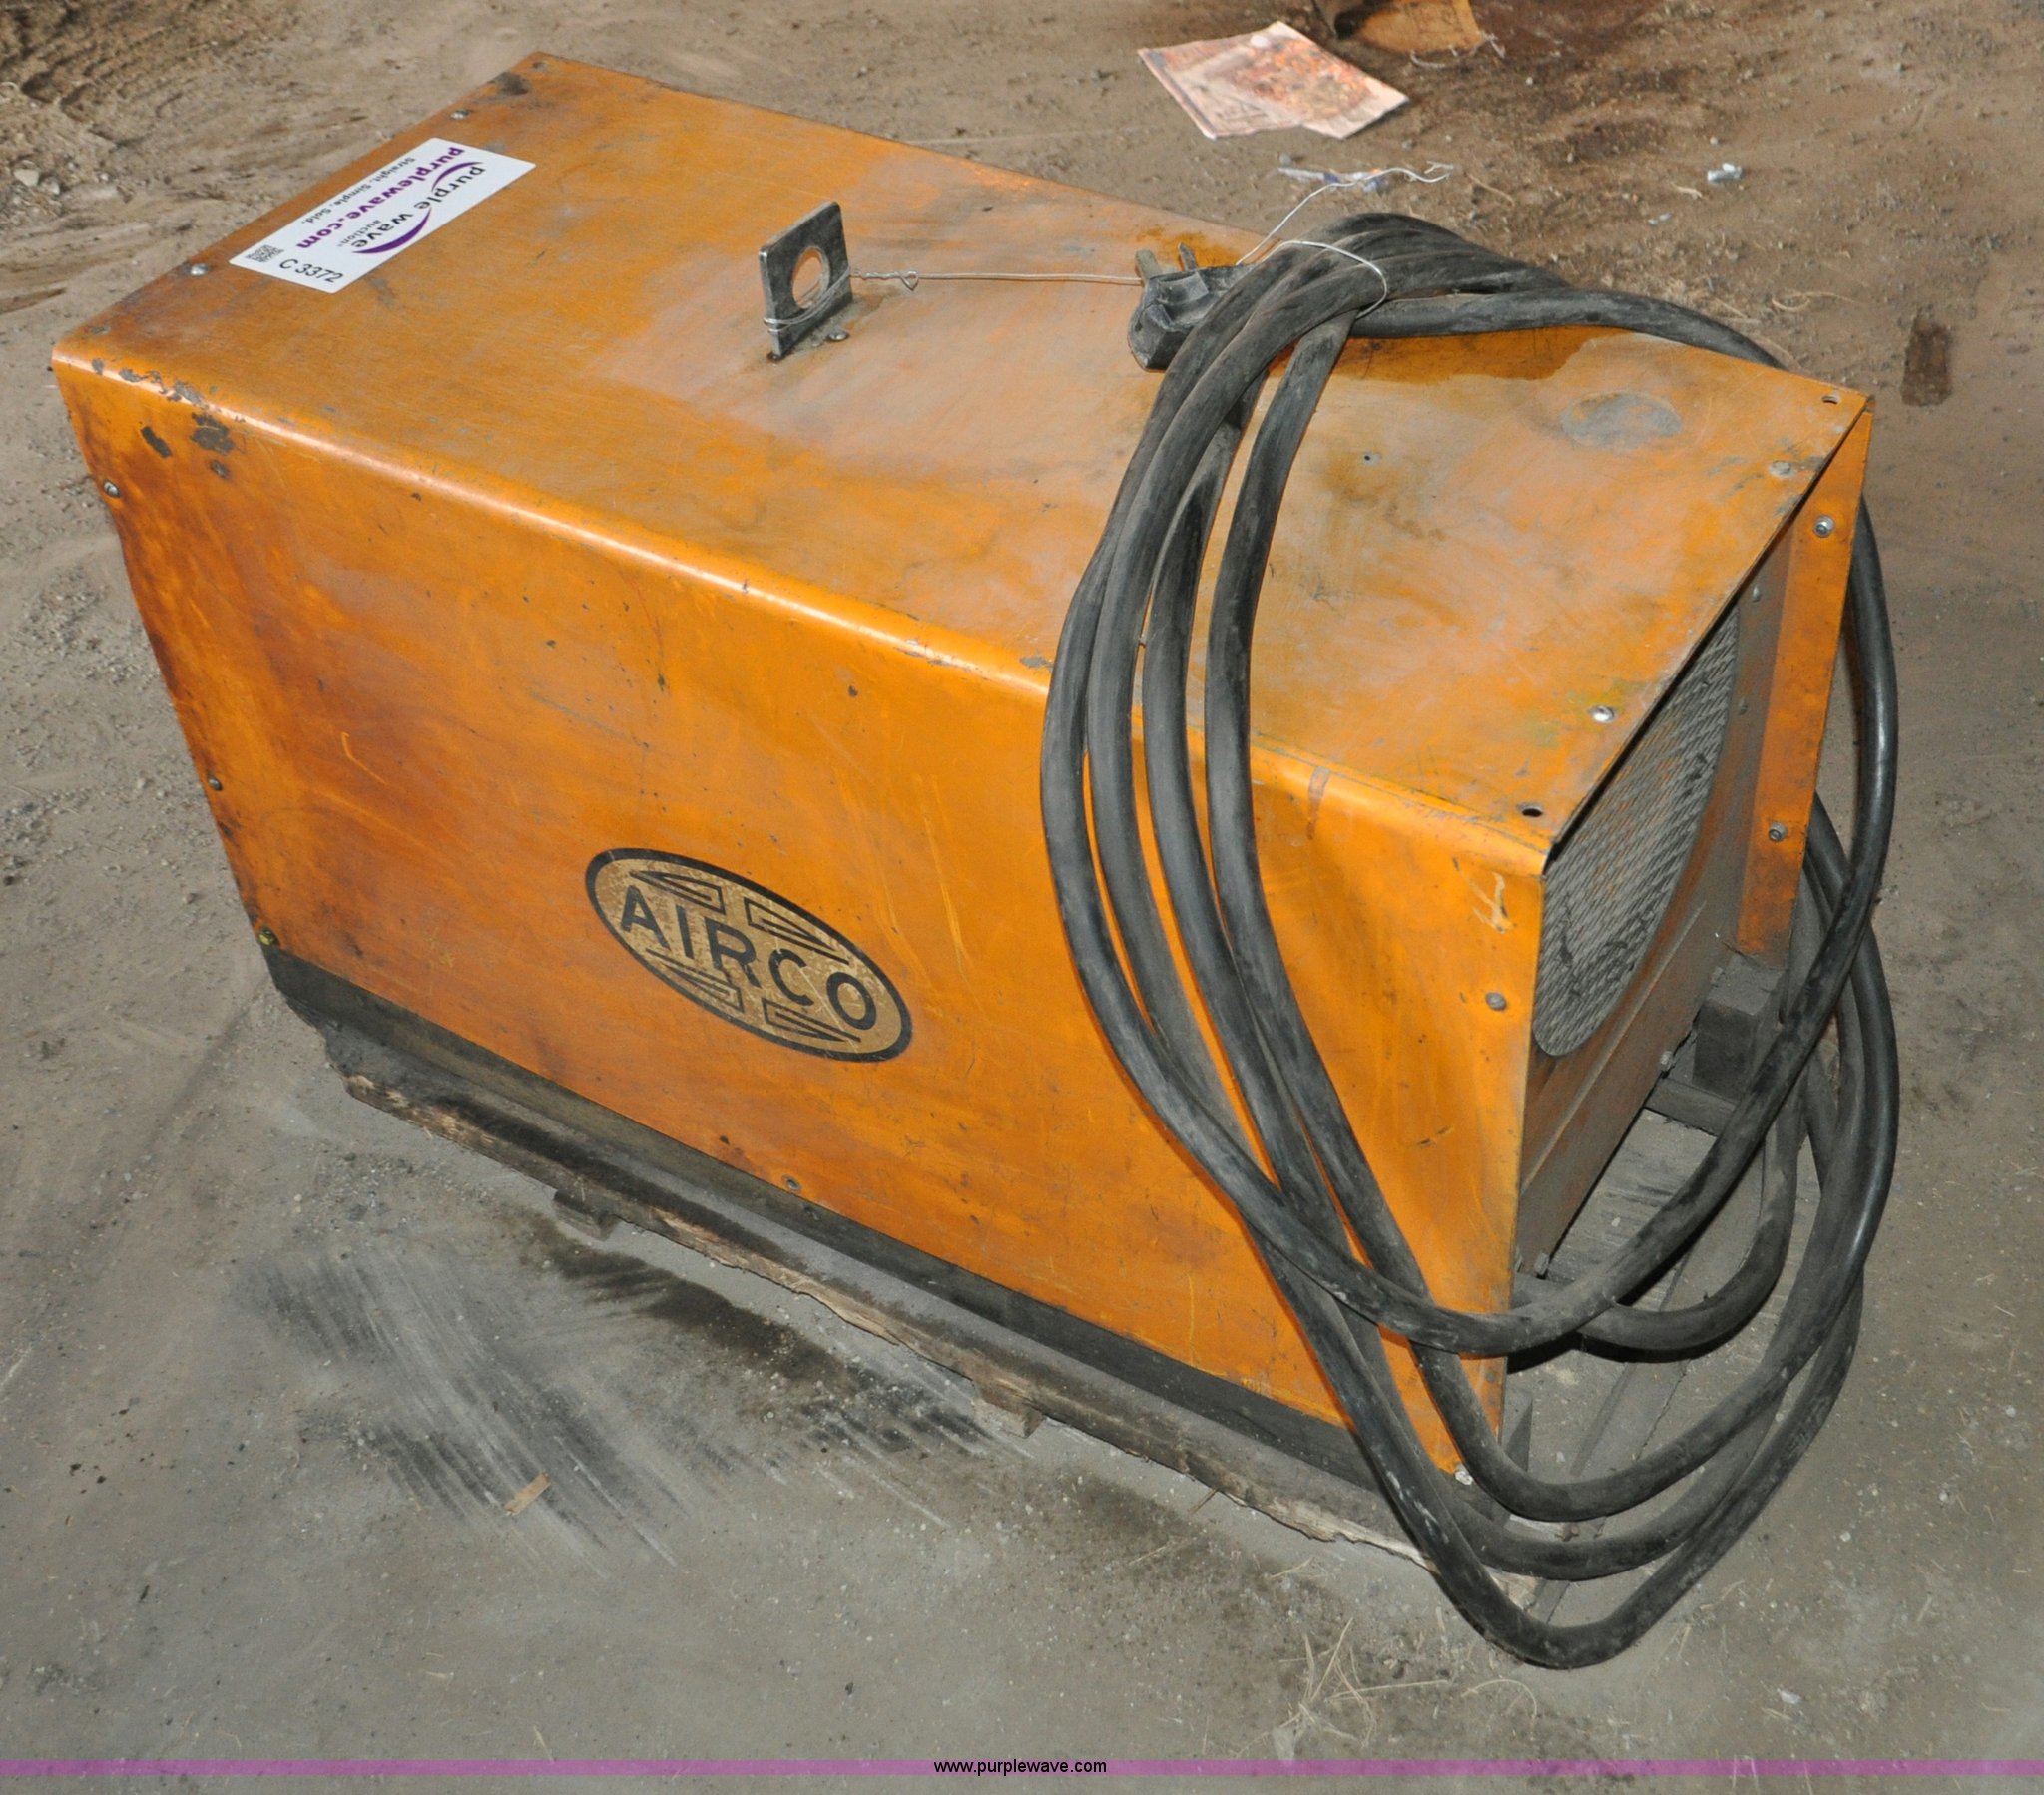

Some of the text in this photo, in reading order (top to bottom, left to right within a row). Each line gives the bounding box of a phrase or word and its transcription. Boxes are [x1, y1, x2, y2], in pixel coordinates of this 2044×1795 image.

[296, 146, 465, 249] purplewave.com
[351, 166, 486, 249] purple wave
[278, 258, 344, 284] C 3372
[620, 884, 877, 1031] AIRCO
